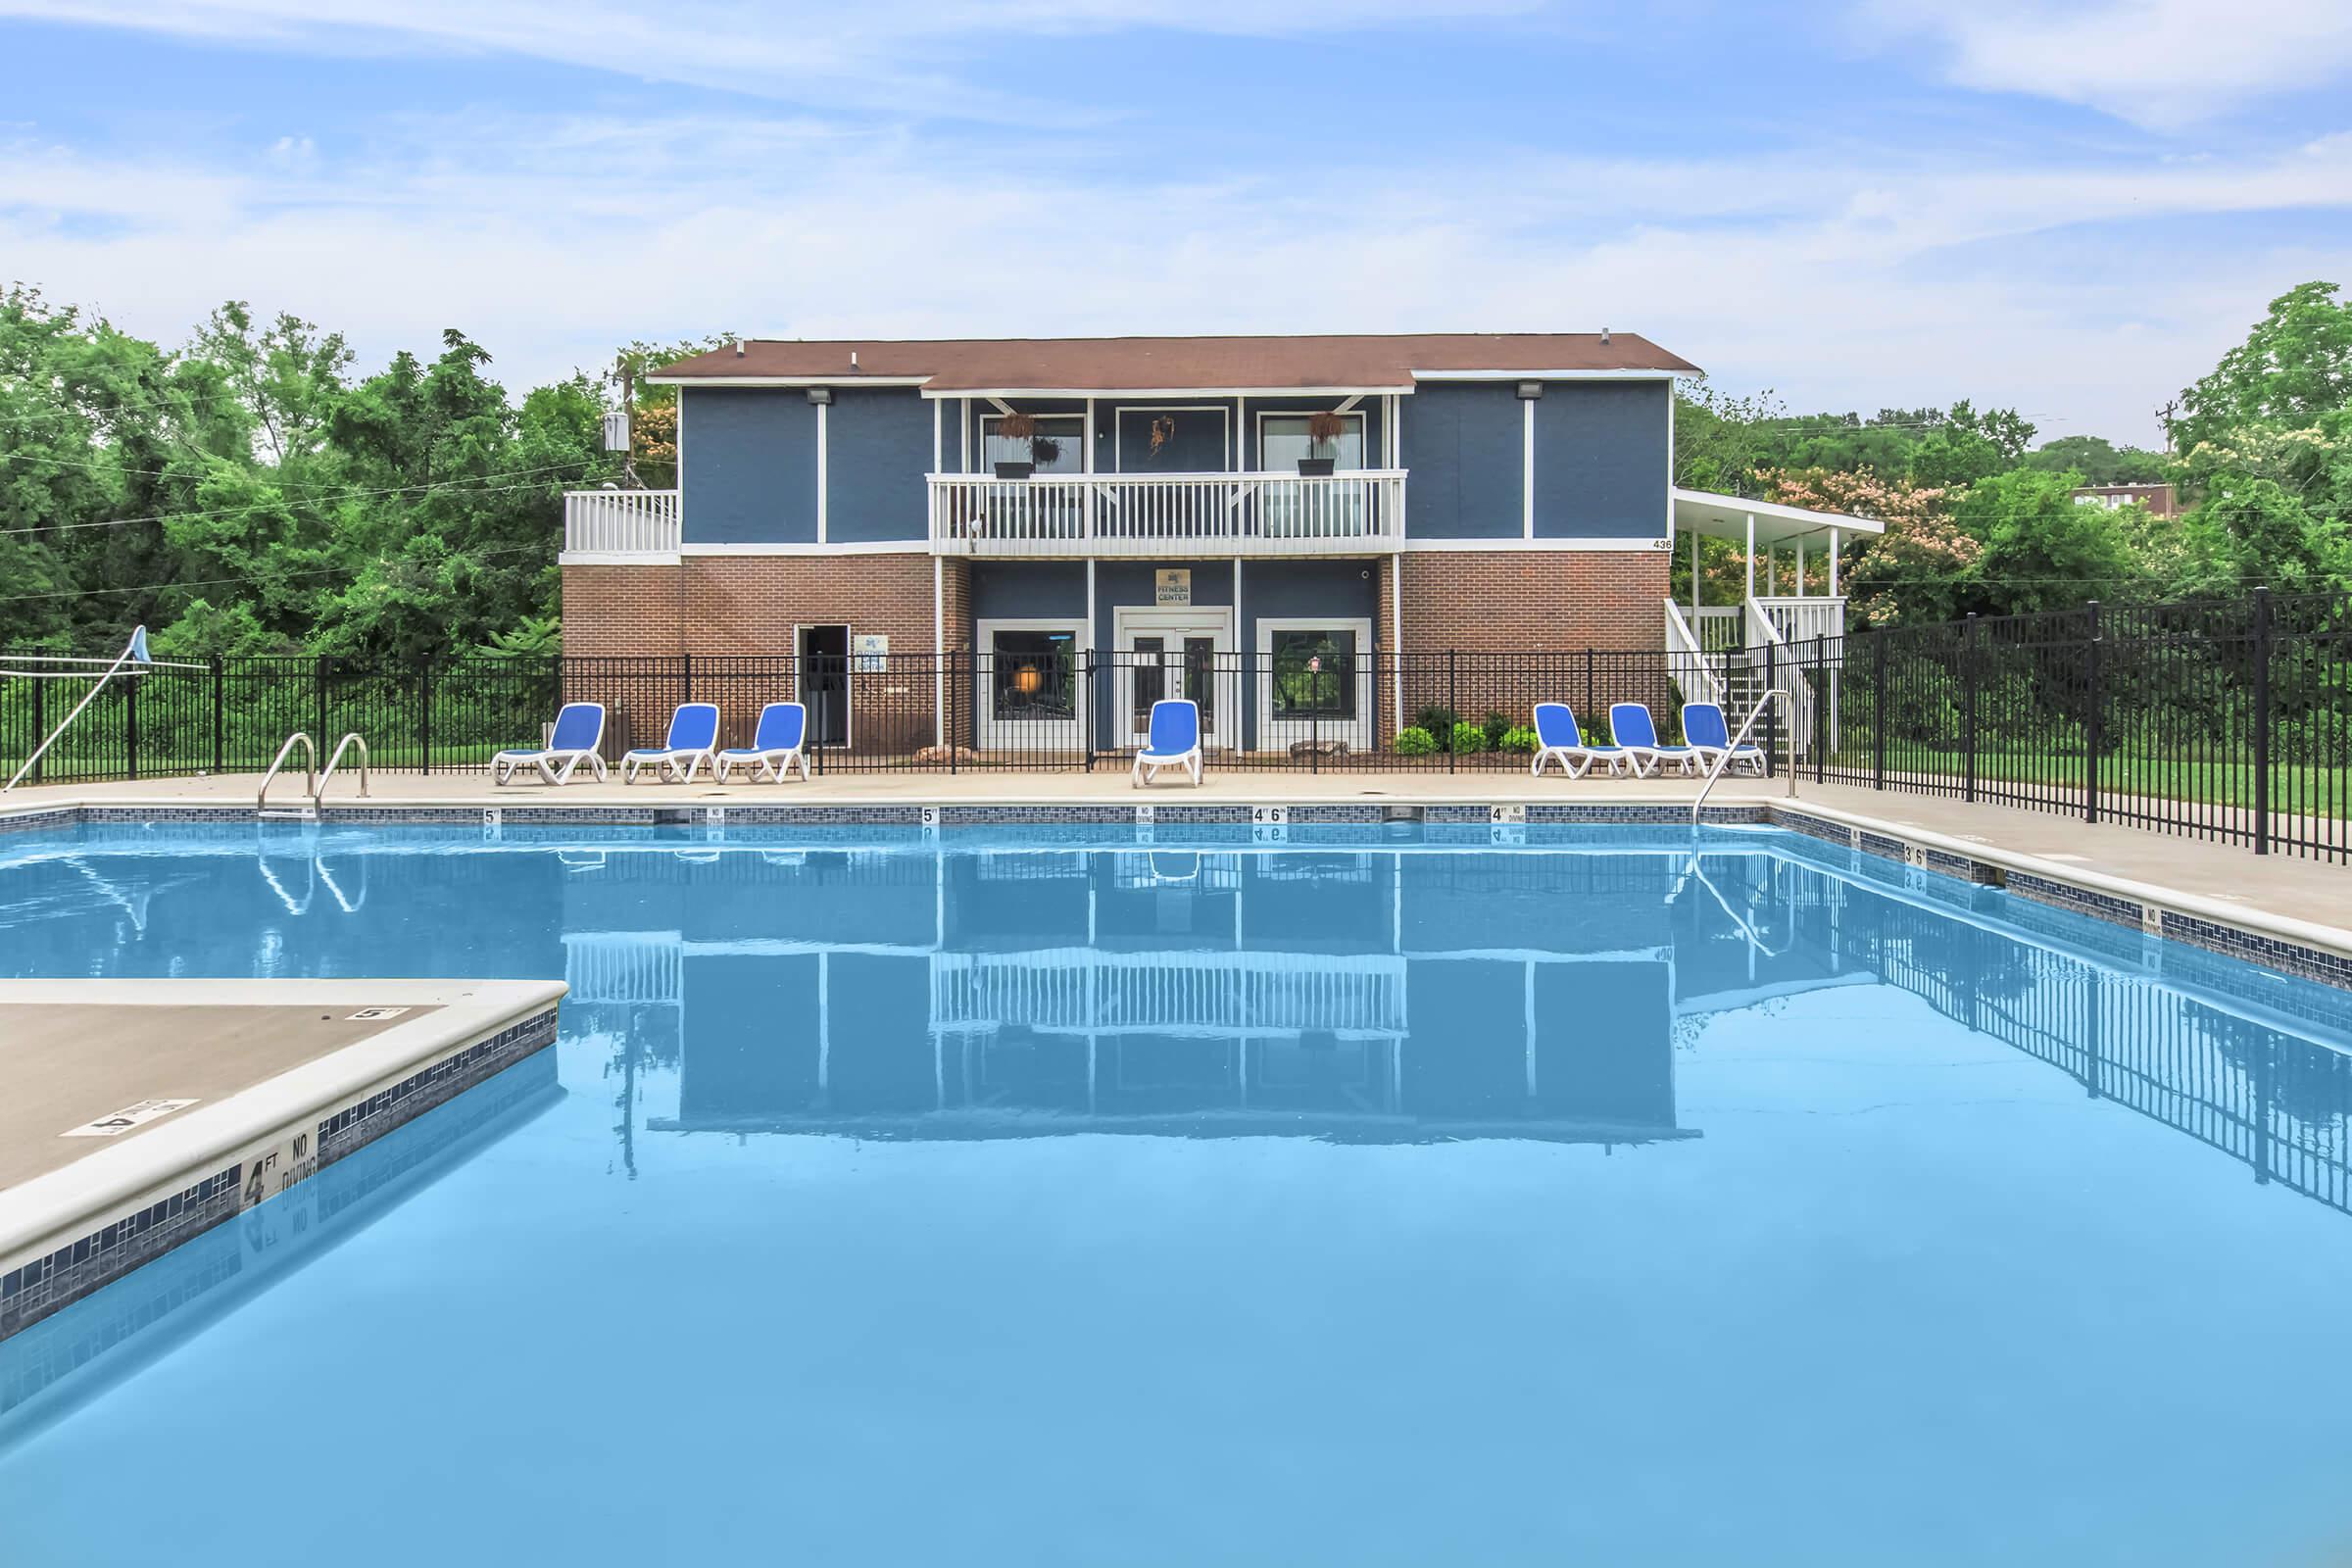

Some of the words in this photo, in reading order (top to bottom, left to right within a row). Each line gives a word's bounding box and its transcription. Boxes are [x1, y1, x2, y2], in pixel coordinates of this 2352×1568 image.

[486, 810, 494, 823] 5
[924, 809, 932, 821] 5
[1254, 808, 1263, 821] 4
[1271, 808, 1279, 821] 6
[1493, 808, 1500, 820] 4
[1906, 847, 1912, 861] 3
[1916, 849, 1923, 864] 6
[2147, 908, 2156, 922] NO
[355, 1009, 386, 1018] 5
[90, 1118, 135, 1128] 4
[292, 1134, 308, 1161] NO
[244, 1158, 264, 1205] 4
[265, 1152, 279, 1173] FT
[281, 1156, 317, 1191] DIVING
